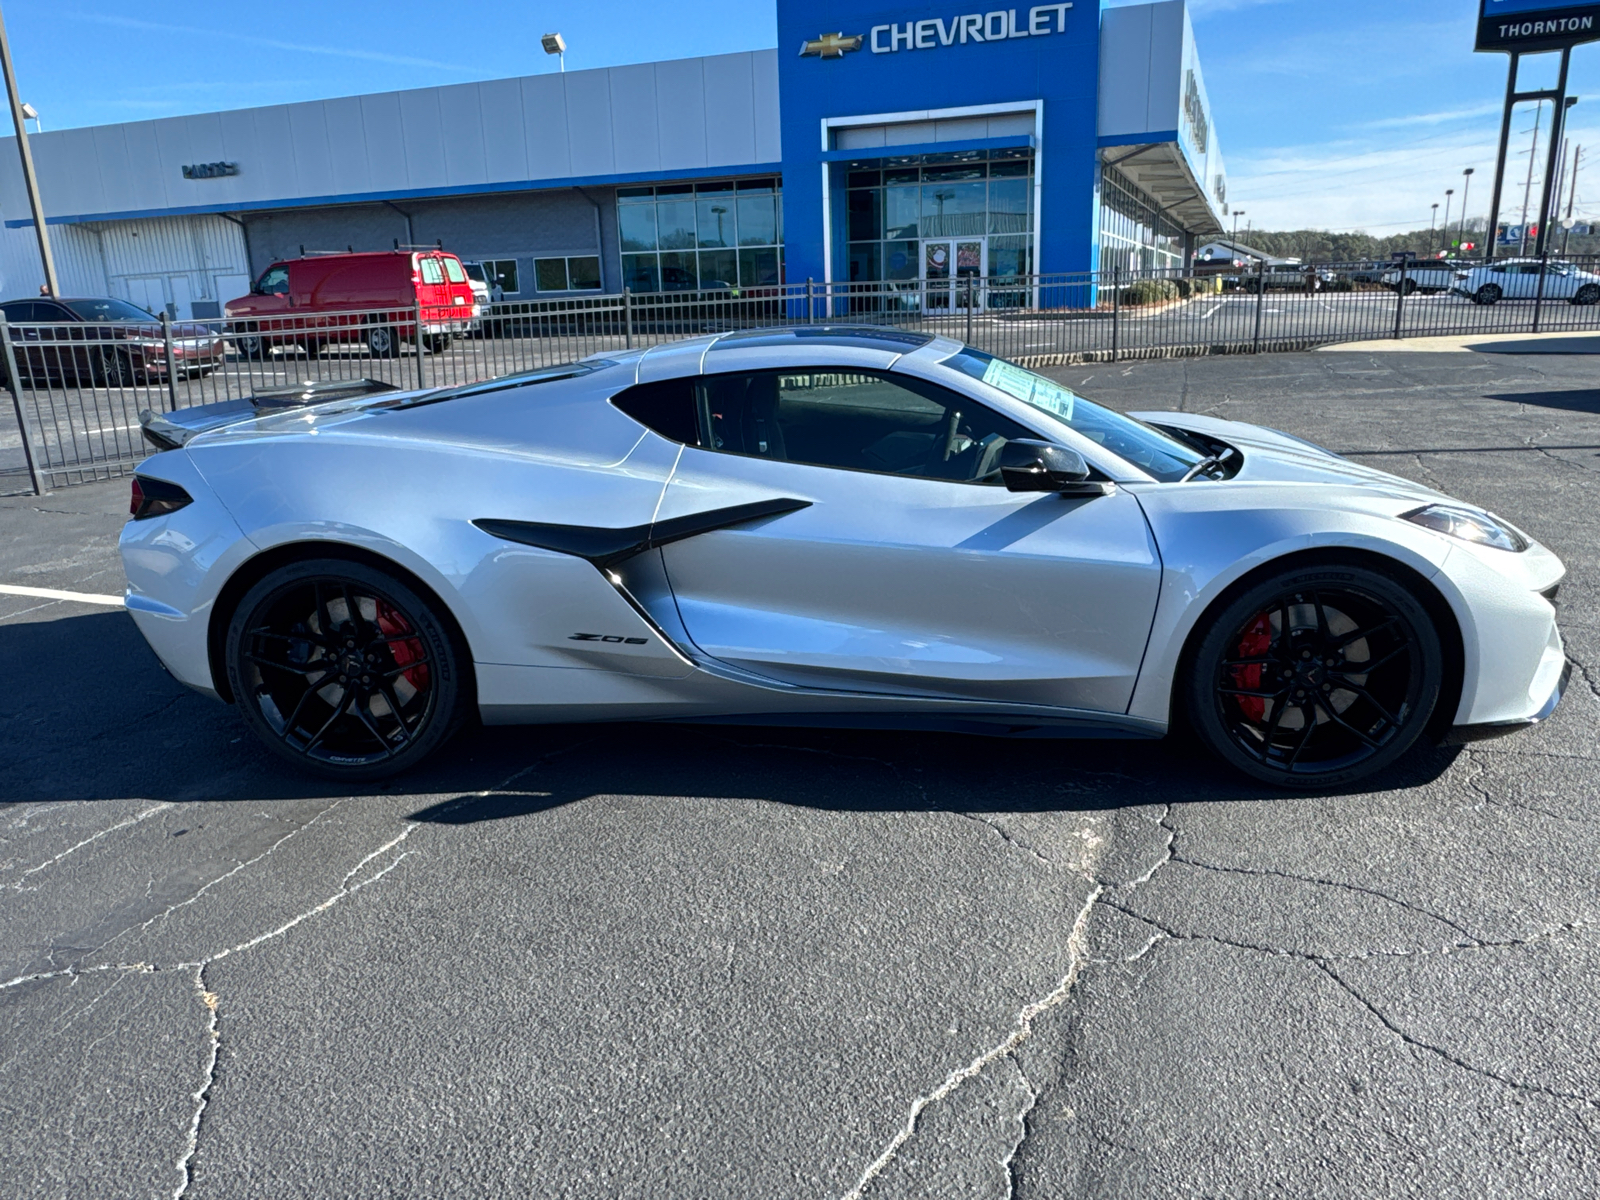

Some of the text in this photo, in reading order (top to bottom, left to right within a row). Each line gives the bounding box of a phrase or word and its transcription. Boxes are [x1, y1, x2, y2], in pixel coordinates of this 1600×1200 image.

[871, 2, 1073, 53] CHEVROLET
[1499, 16, 1593, 37] THORNTON
[182, 161, 232, 179] PARTS
[567, 632, 649, 645] Z06
